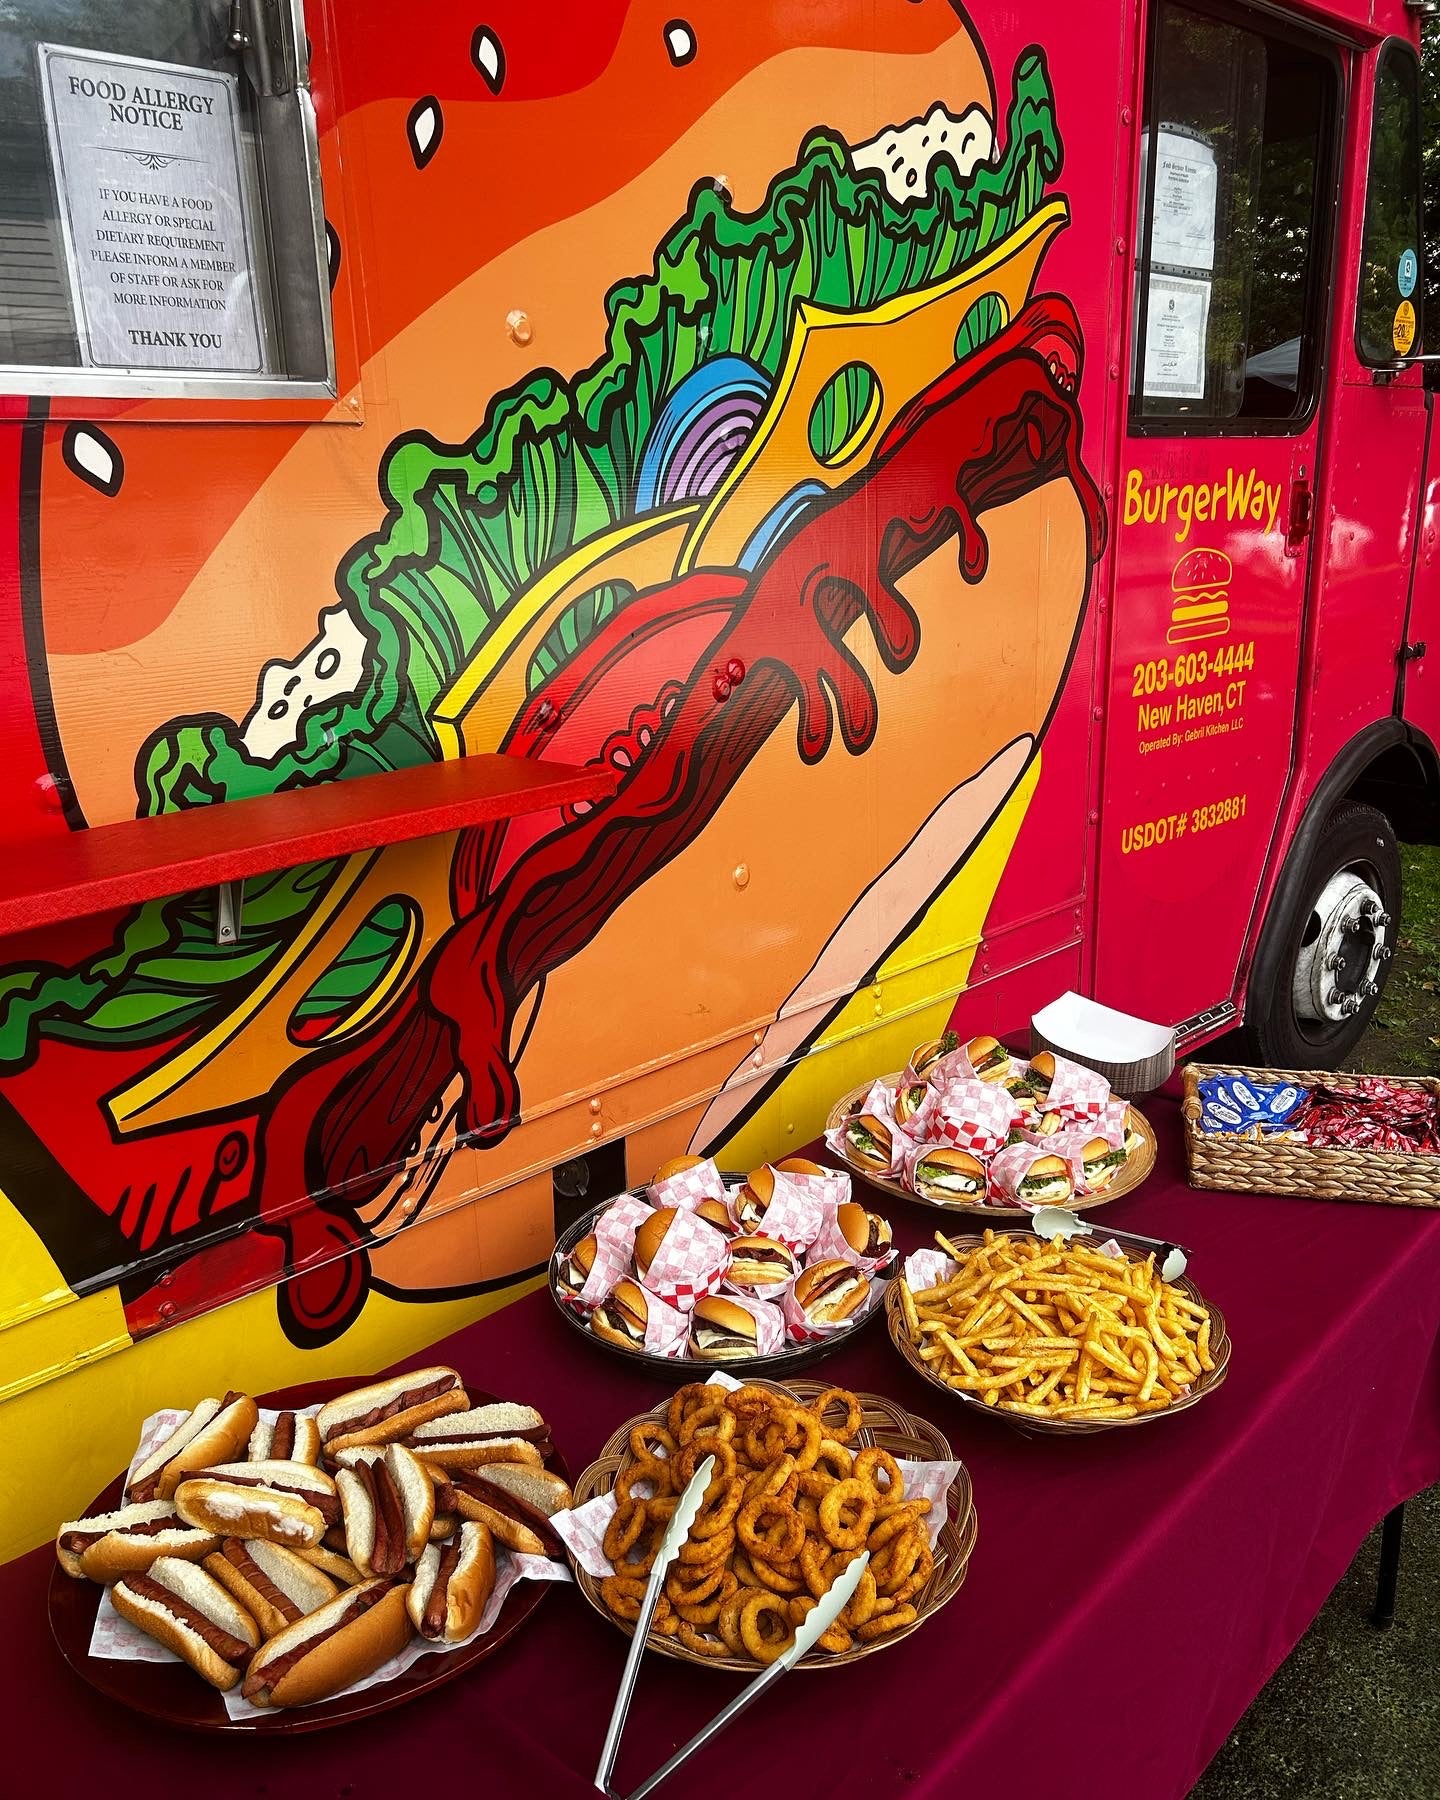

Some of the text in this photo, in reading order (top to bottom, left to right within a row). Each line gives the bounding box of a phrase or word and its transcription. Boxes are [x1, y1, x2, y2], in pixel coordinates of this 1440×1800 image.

[68, 76, 214, 115] FOOD ALLERGY
[109, 103, 184, 131] NOTICE
[99, 188, 213, 211] IF YOU HAVE A FOOD
[102, 210, 216, 231] ALLERGY OR SPECIAL
[96, 230, 226, 253] DIETARY REQUIREMENT
[90, 249, 236, 274] PLEASE INFORM A MEMBER
[110, 272, 224, 292] OF STAFF OR ASK FOR
[114, 293, 226, 311] MORE INFORMATION
[128, 329, 222, 349] THANK YOU
[1123, 467, 1282, 543] BurgerWay
[1132, 641, 1255, 698] 203-603-4444
[1138, 703, 1172, 732] New
[1139, 717, 1244, 756] Operated By: Gebril Kitchen LLC
[1121, 794, 1246, 854] USDOT# 3832881
